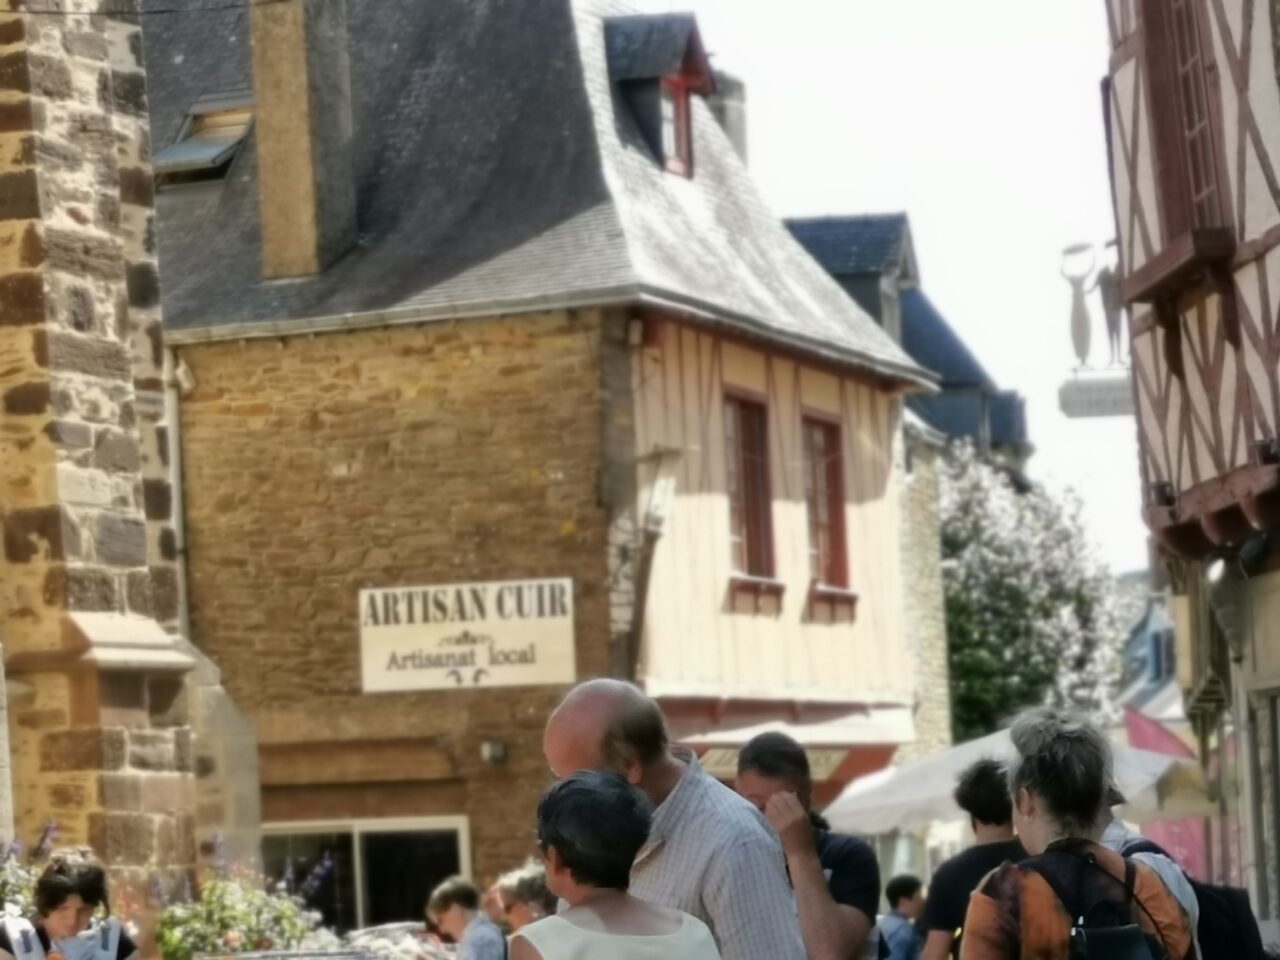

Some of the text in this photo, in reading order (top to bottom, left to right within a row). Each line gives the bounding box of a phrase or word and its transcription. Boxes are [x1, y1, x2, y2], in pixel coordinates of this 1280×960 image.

[364, 583, 569, 627] ARTISAN CUIR
[386, 642, 537, 671] Artisanat local
